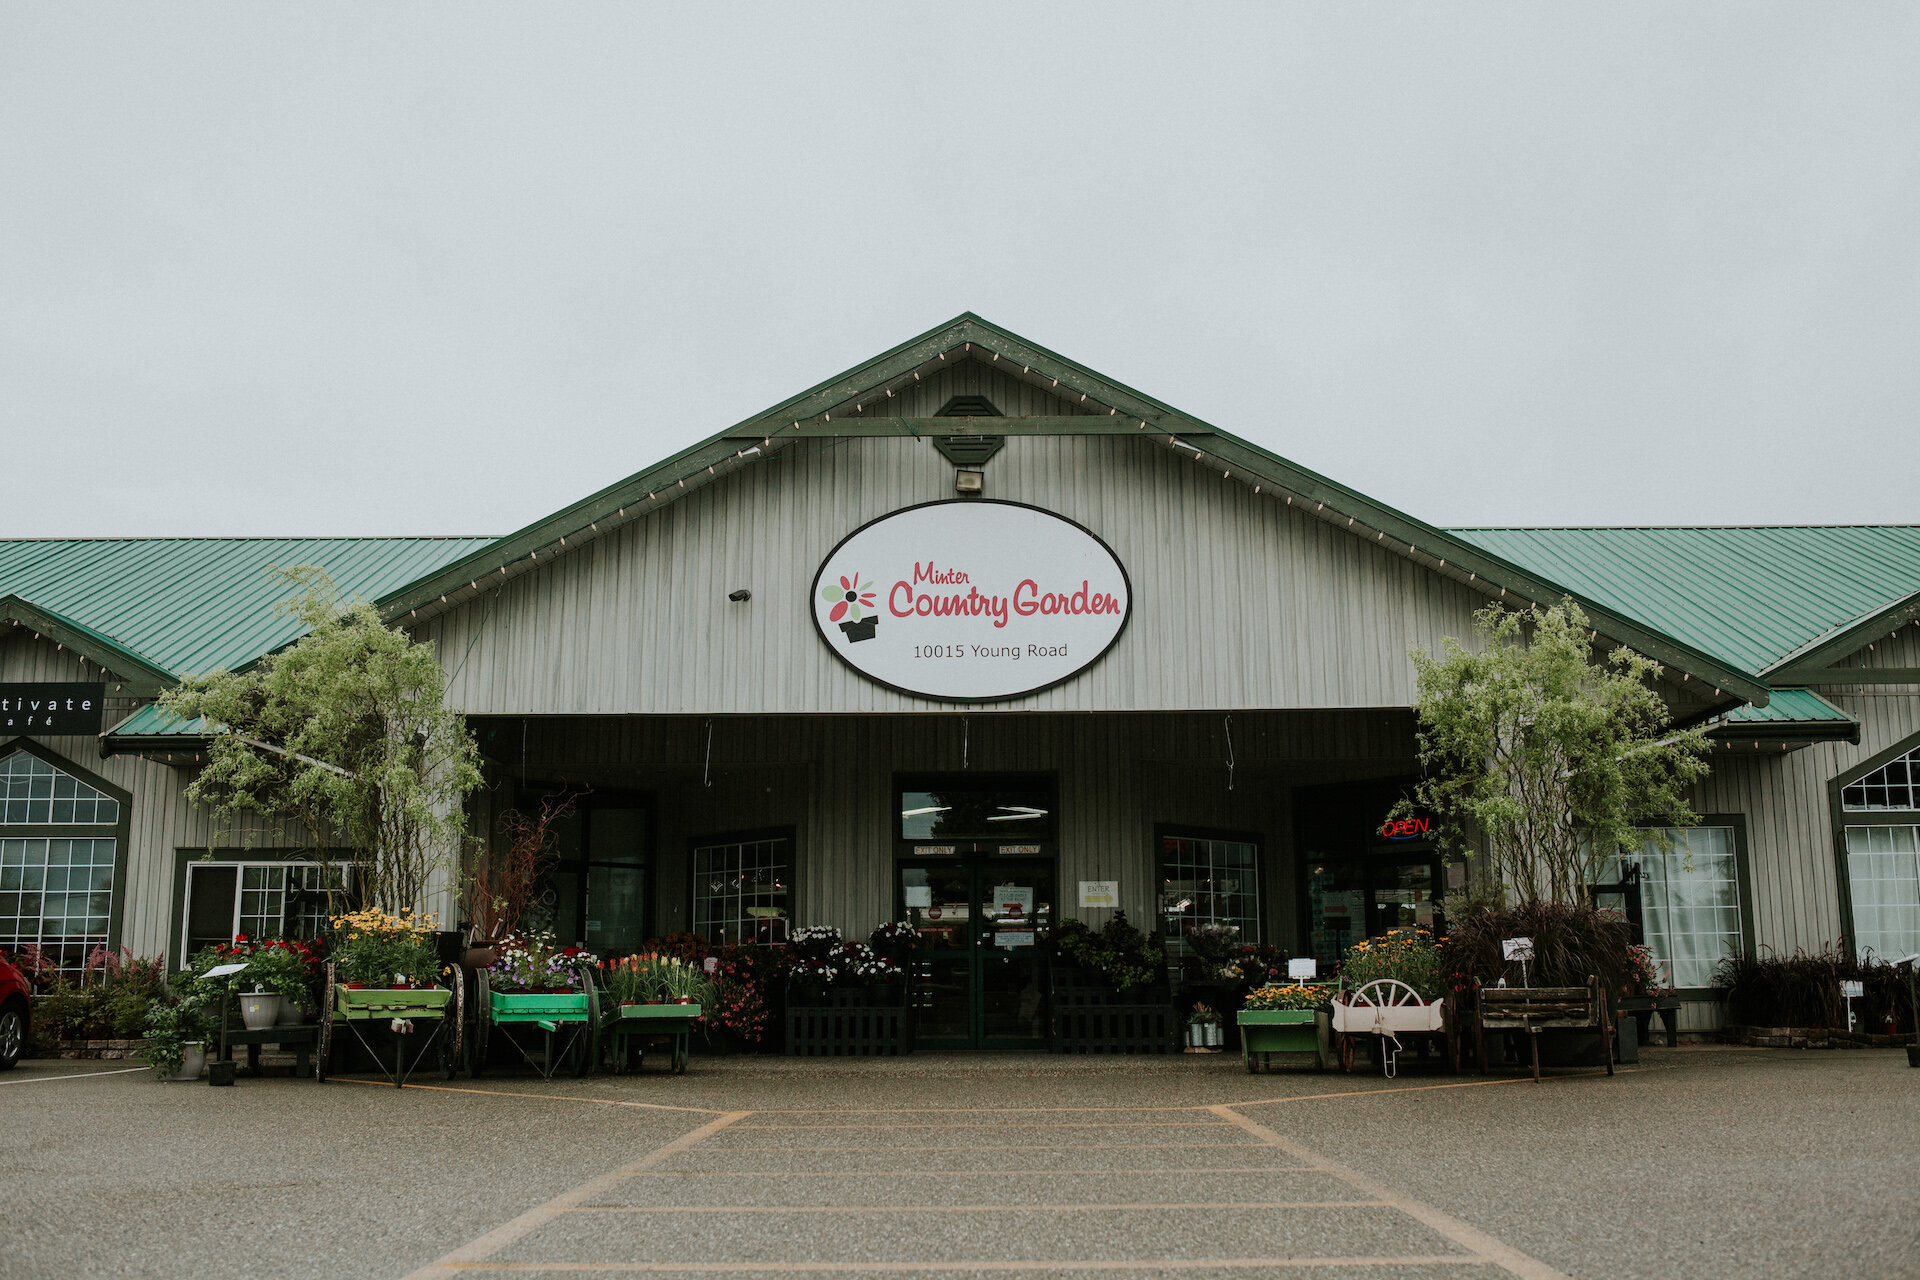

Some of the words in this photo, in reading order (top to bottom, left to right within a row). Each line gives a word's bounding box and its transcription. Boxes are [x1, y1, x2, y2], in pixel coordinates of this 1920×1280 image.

[913, 560, 970, 586] Minter
[888, 580, 1009, 629] Country
[1013, 578, 1121, 617] Garden
[914, 644, 965, 658] 10015
[970, 644, 1021, 660] Young
[1028, 643, 1068, 657] Road
[2, 697, 91, 711] tivate
[1382, 817, 1429, 836] OPEN
[915, 846, 931, 854] EXIT
[933, 846, 952, 854] ONLY
[1000, 846, 1018, 854] EXIT
[1019, 845, 1038, 853] ONLY
[1087, 885, 1110, 893] ENTER
